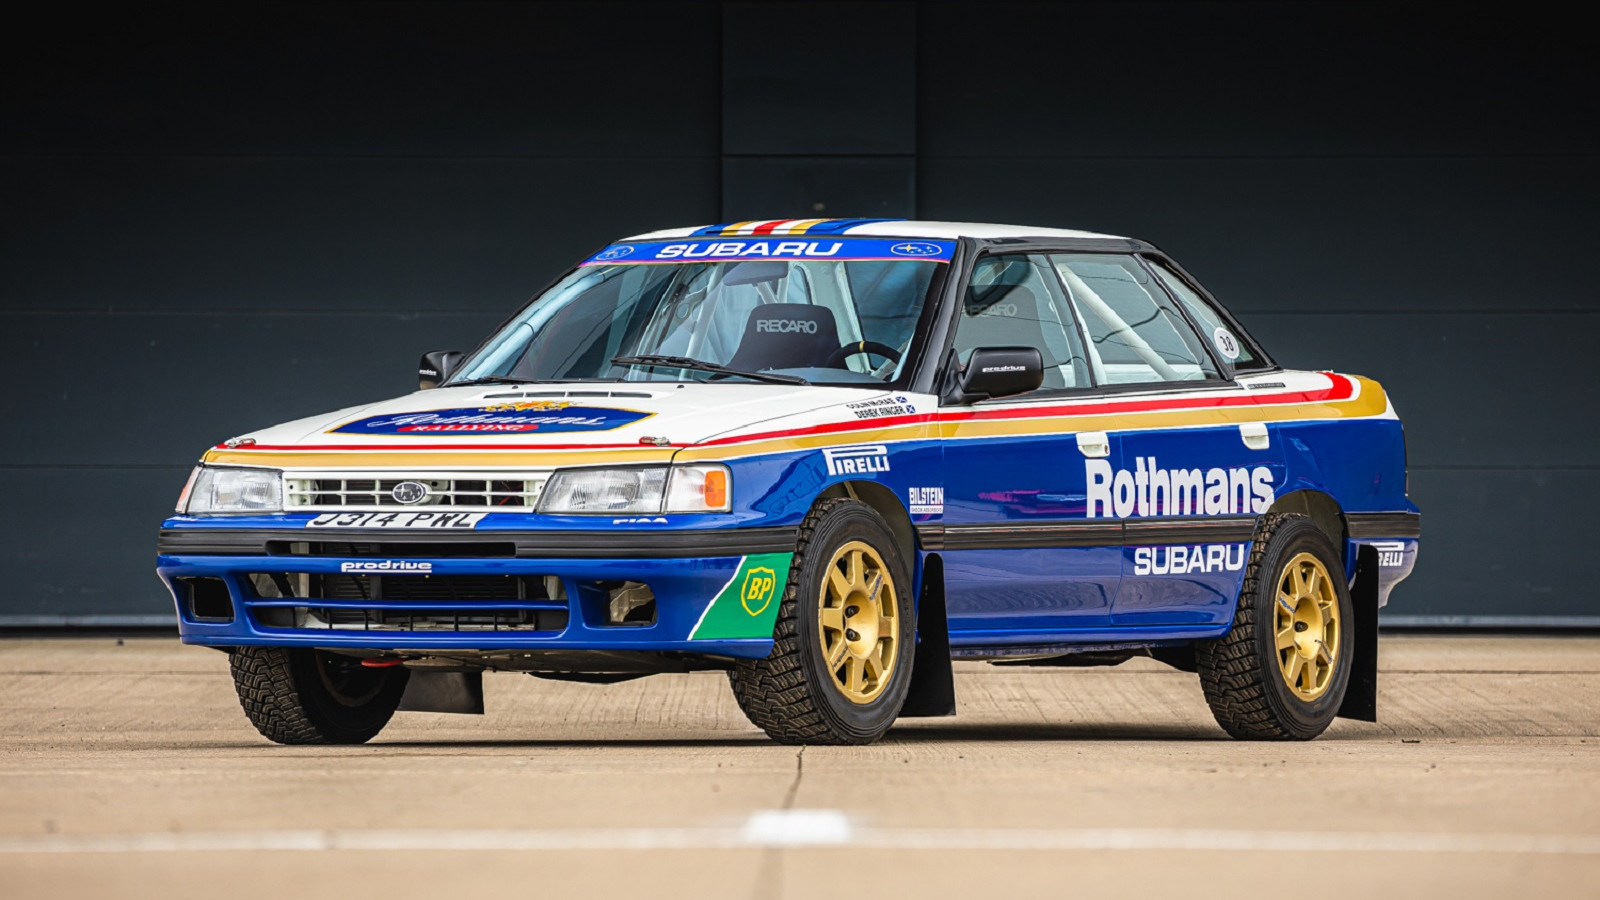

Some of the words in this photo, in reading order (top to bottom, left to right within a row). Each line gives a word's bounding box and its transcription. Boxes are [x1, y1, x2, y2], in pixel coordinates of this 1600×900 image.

[655, 241, 843, 259] SUBARU
[756, 319, 818, 334] RECARO
[1219, 335, 1234, 351] 38
[854, 408, 880, 419] DEREK
[879, 405, 906, 417] RINGER
[821, 445, 890, 476] PIRELLI
[908, 487, 944, 505] BILSTEIN
[1085, 456, 1275, 518] Rothmans
[314, 512, 397, 527] J314
[341, 560, 432, 573] prodrive
[1134, 544, 1245, 576] SUBARU
[747, 577, 772, 600] BP
